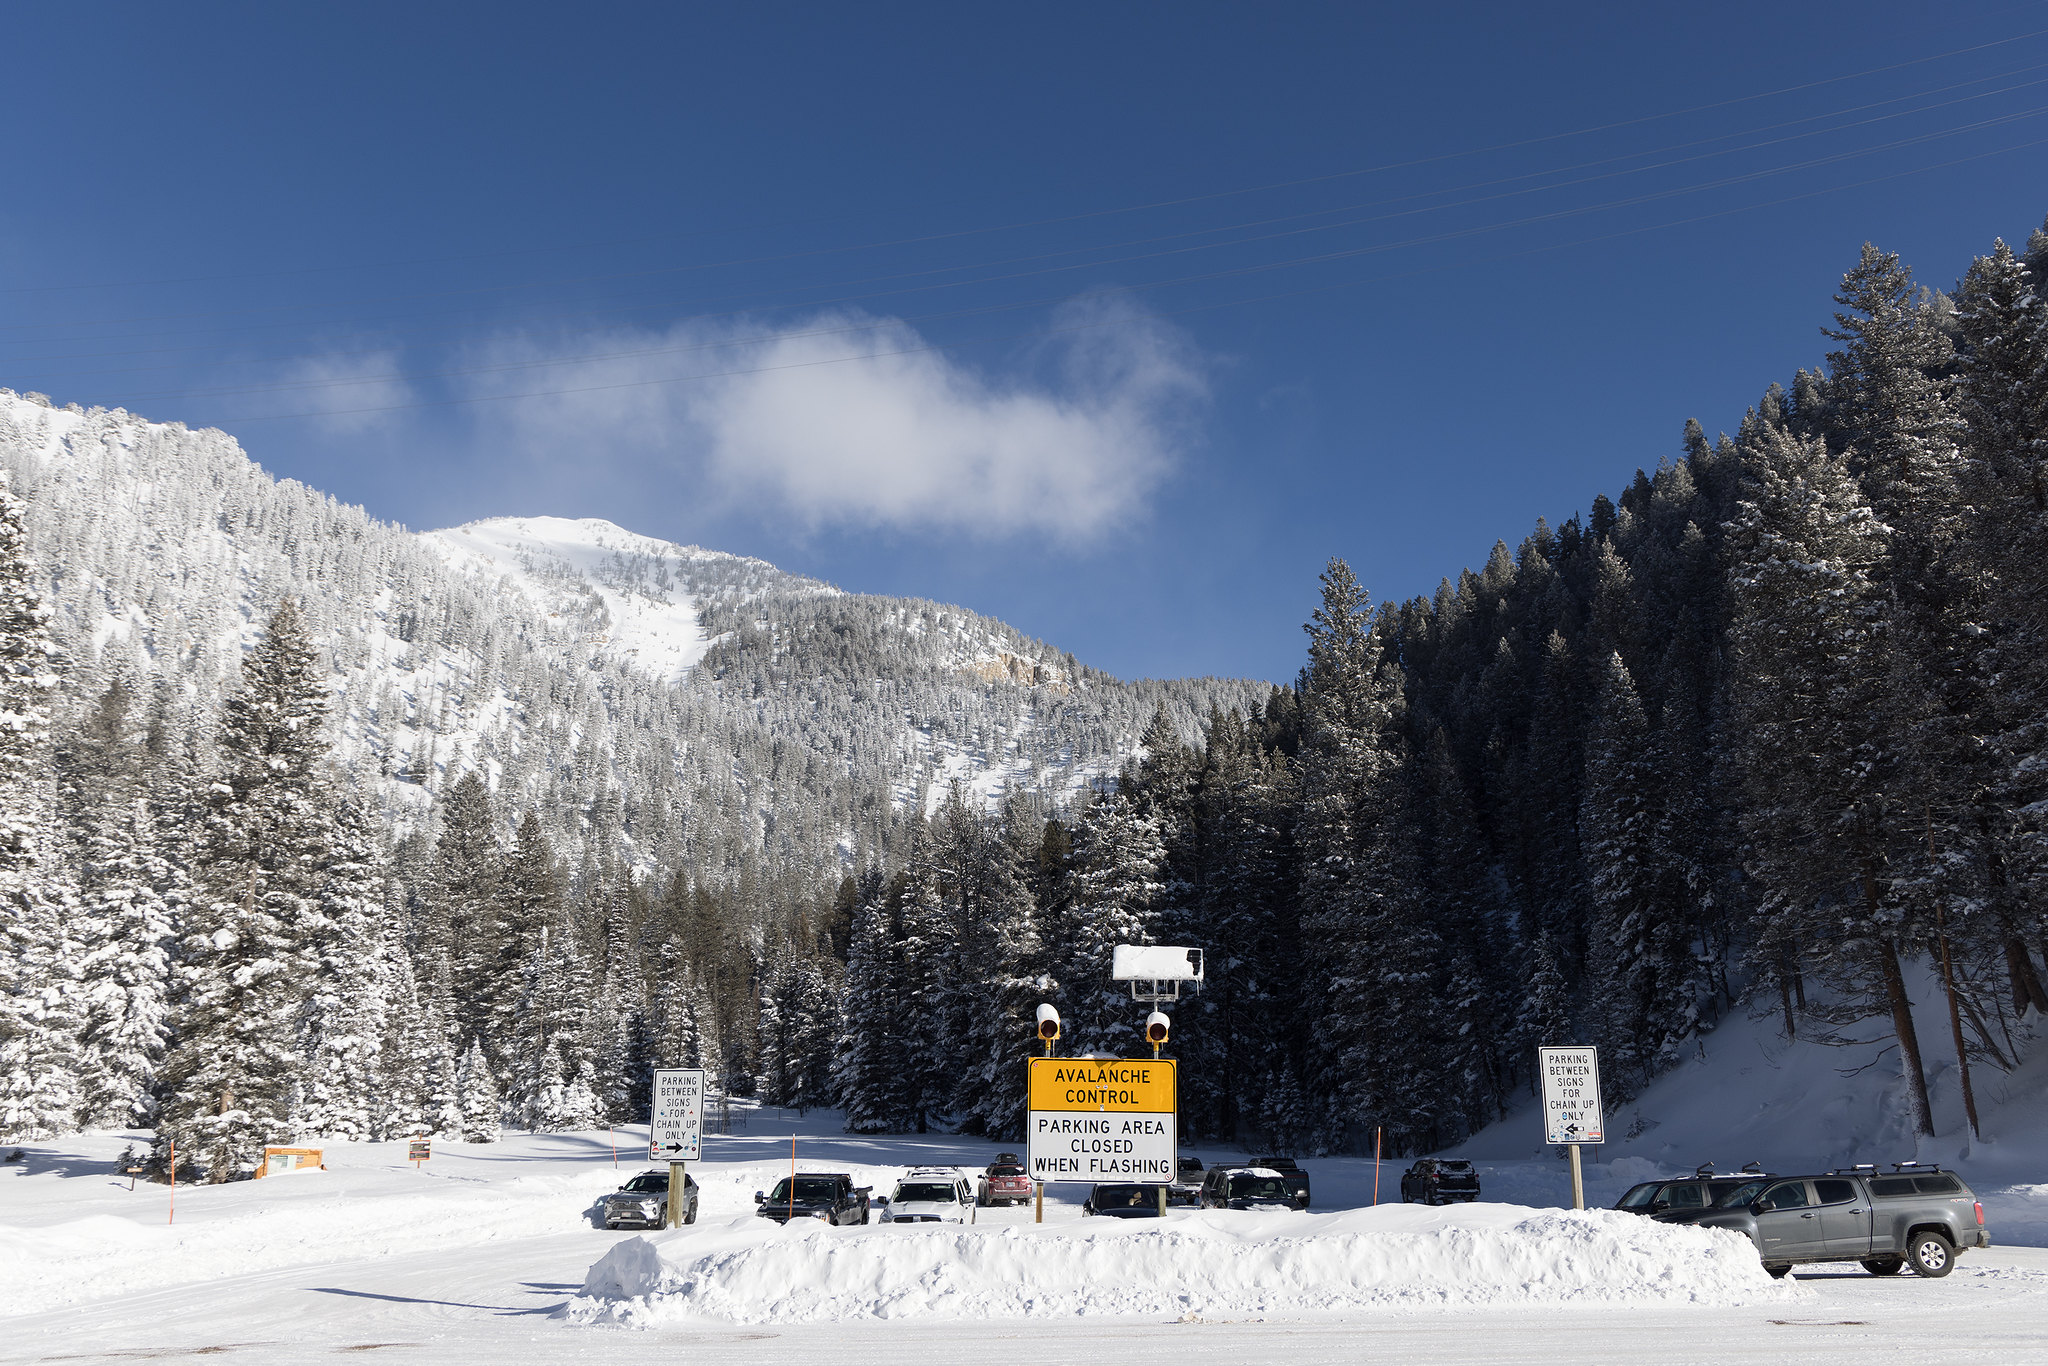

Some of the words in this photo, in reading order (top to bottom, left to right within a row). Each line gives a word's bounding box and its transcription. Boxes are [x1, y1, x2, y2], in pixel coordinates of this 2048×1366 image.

[1549, 1055, 1588, 1064] PARKING
[1055, 1069, 1150, 1083] AVALANCHE
[1550, 1066, 1590, 1076] BETWEEN
[662, 1076, 697, 1086] PARKING
[1557, 1077, 1584, 1087] SIGNS
[661, 1087, 697, 1096] BETWEEN
[1562, 1089, 1581, 1098] FOR
[1066, 1090, 1139, 1104] CONTROL
[666, 1098, 691, 1107] SIGNS
[1550, 1100, 1577, 1110] CHAIN
[1583, 1100, 1595, 1109] UP
[669, 1109, 686, 1118] FOR
[1562, 1111, 1585, 1121] ONLY
[656, 1120, 681, 1129] CHAIN
[686, 1120, 697, 1129] UP
[1039, 1119, 1110, 1134] PARKING
[1121, 1120, 1165, 1135] AREA
[665, 1131, 687, 1140] ONLY
[1071, 1139, 1133, 1153] CLOSED
[1035, 1158, 1079, 1172] WHEN
[1090, 1159, 1169, 1173] FLASHING
